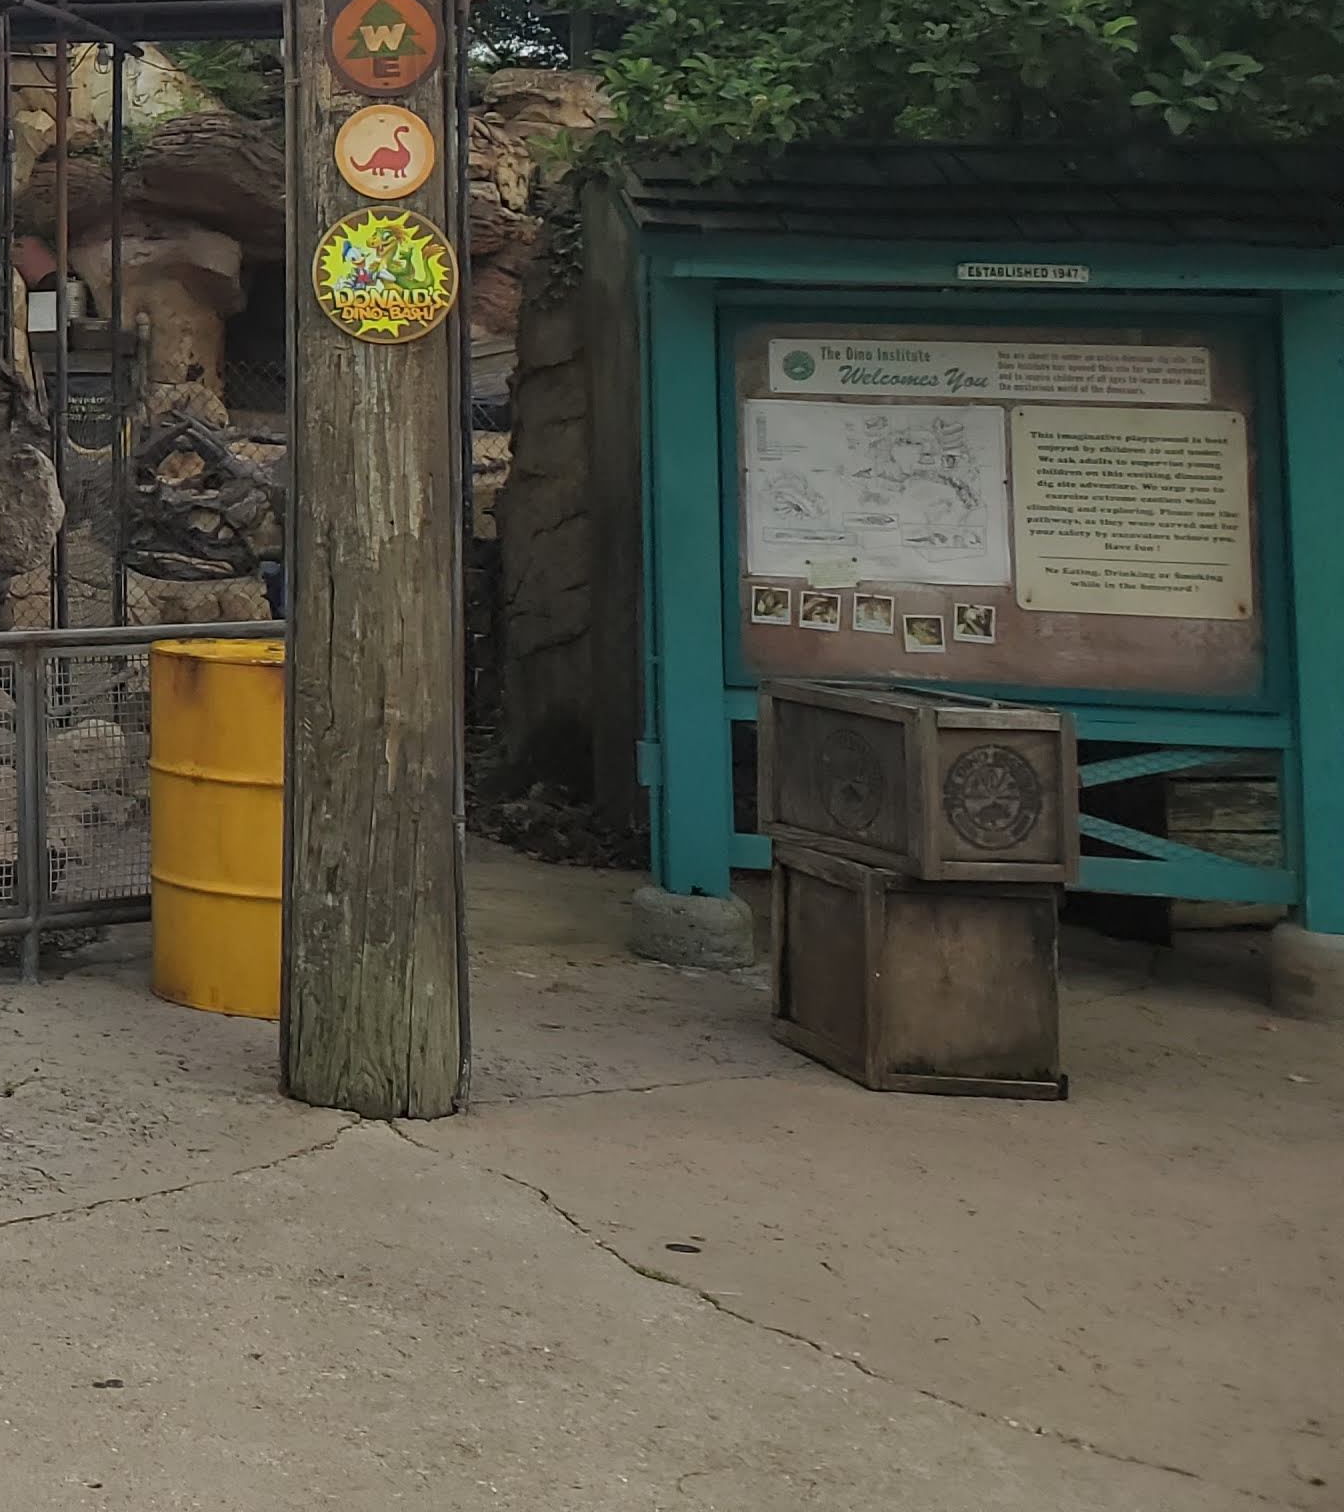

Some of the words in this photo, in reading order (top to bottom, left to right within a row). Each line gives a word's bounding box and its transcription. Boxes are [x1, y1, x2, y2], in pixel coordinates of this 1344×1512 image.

[359, 23, 406, 52] W
[967, 266, 1049, 279] ESTABLISHED
[1052, 268, 1079, 279] 1947
[334, 286, 444, 309] DONALD'S
[820, 346, 841, 361] The
[846, 346, 873, 361] Dino
[877, 347, 931, 363] Institute
[838, 365, 939, 387] Welcomes
[944, 366, 989, 392] You
